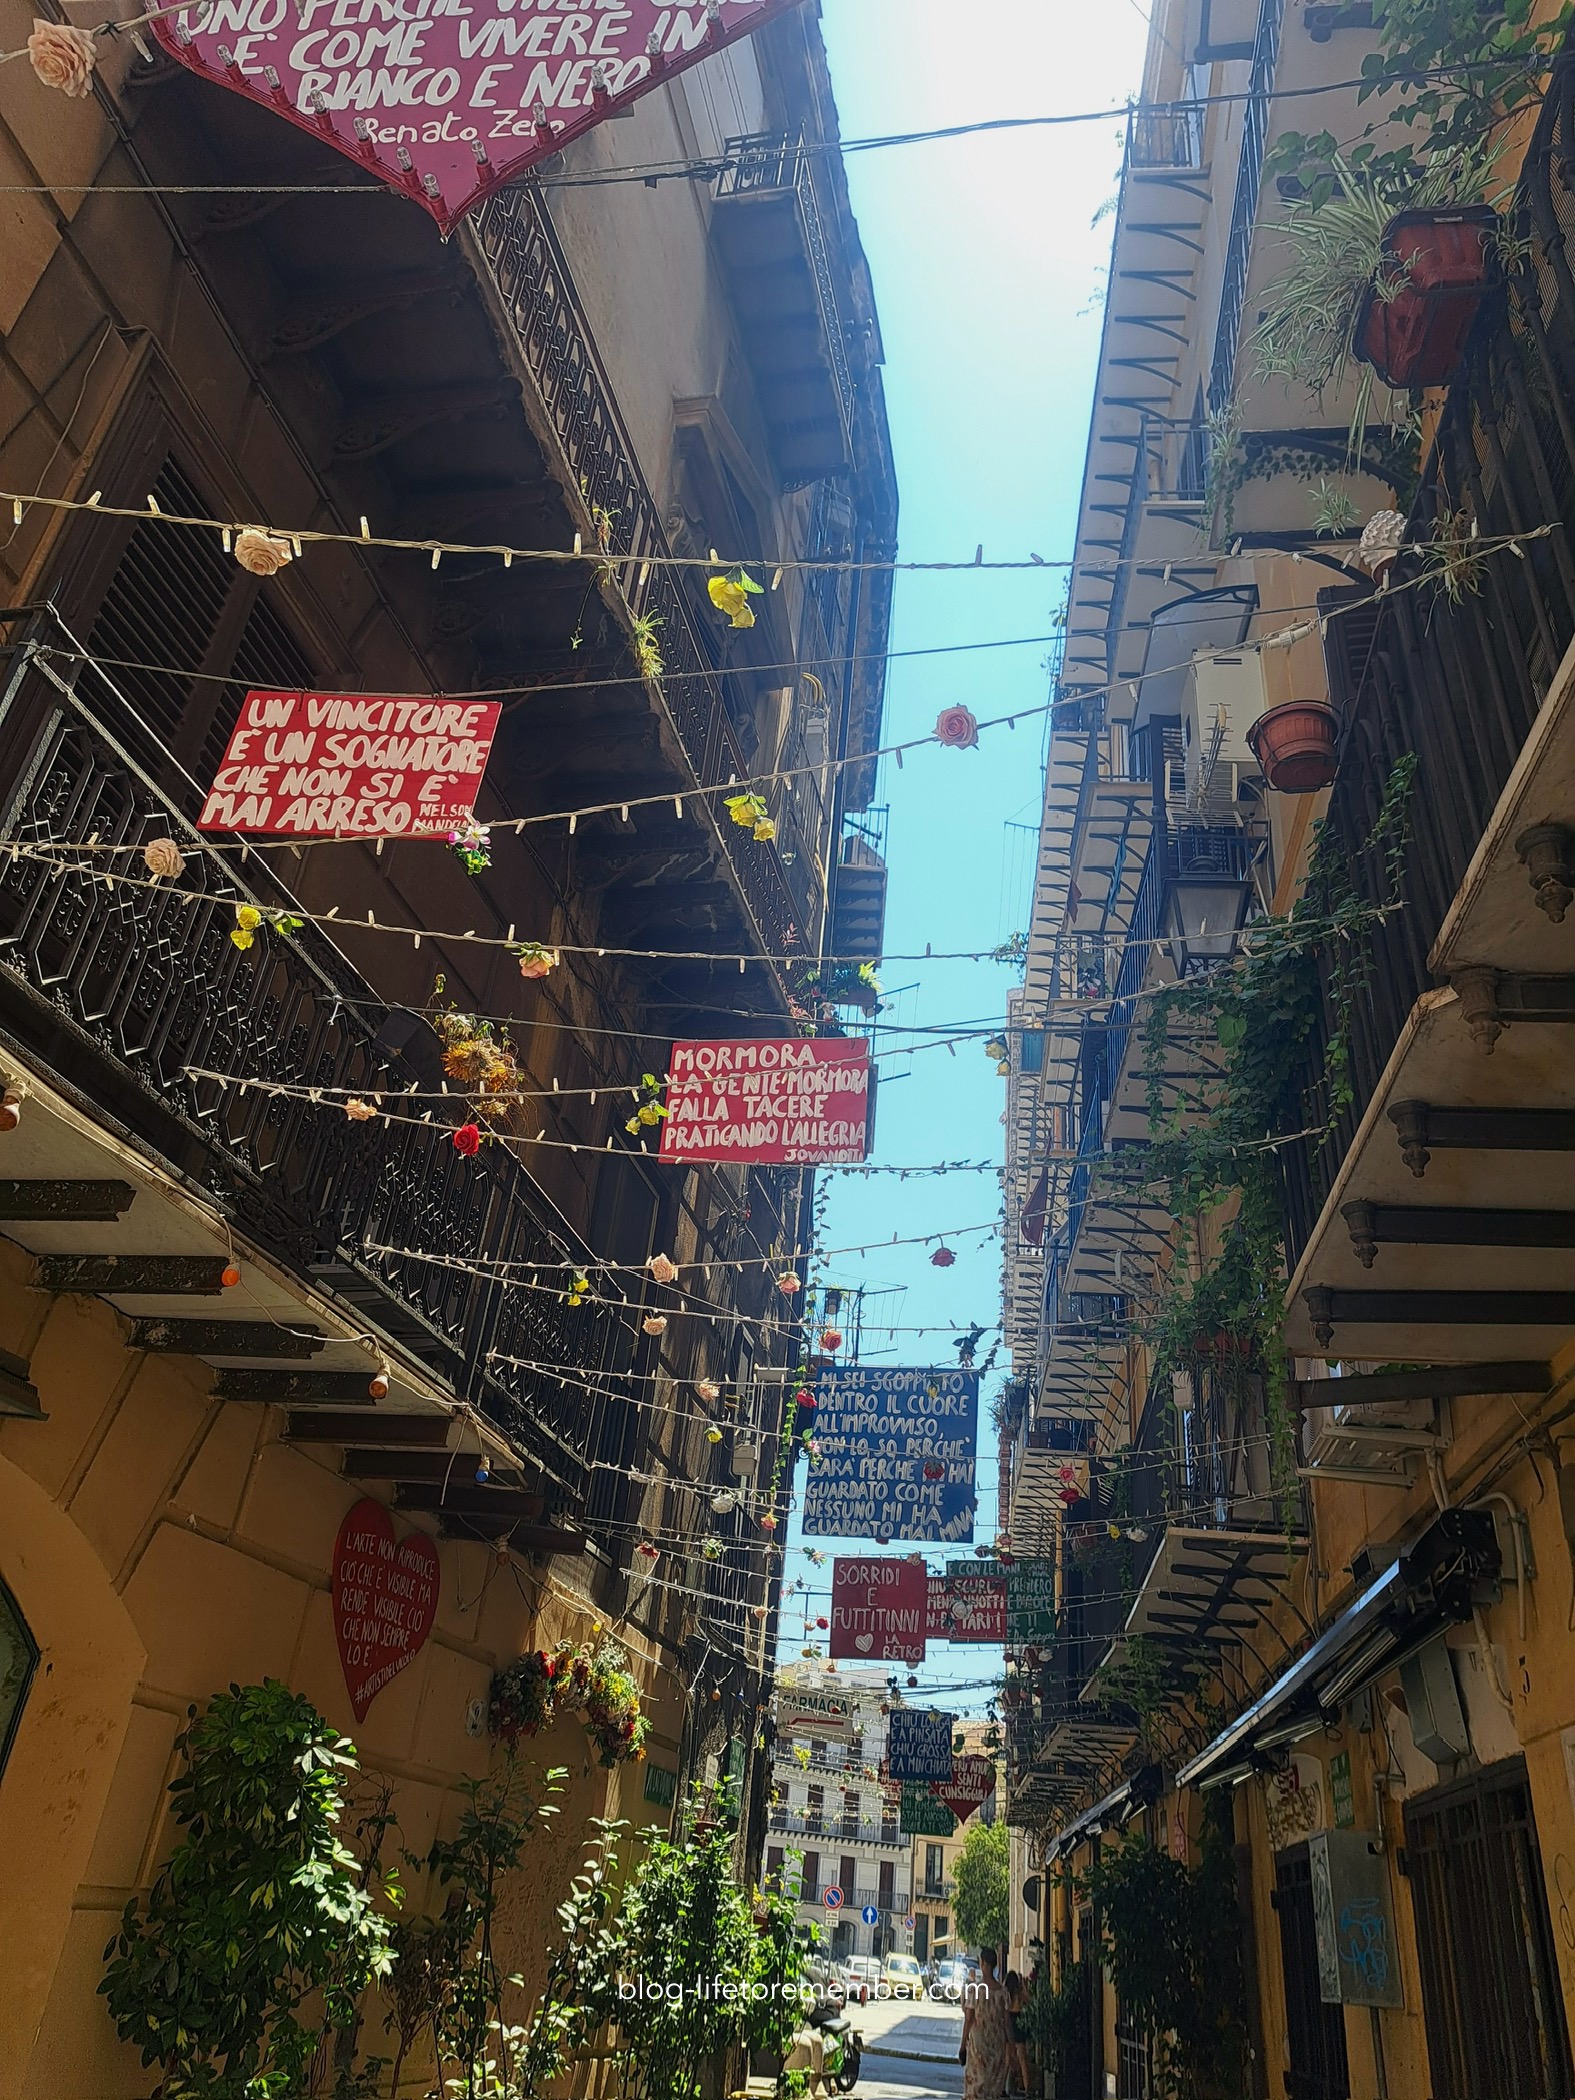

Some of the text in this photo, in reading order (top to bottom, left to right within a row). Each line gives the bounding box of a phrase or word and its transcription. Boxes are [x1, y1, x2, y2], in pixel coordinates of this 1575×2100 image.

[290, 20, 433, 70] COME
[459, 10, 632, 58] VIVERE
[645, 10, 709, 54] IN
[297, 55, 650, 115] BIANCO E NERO
[362, 111, 477, 143] Renato
[248, 699, 488, 737] UN VINCITORE
[264, 731, 317, 764] UN
[319, 734, 490, 774] SOGNATORE
[212, 765, 280, 794] CHE
[278, 767, 352, 797] NON
[359, 773, 404, 799] SI
[201, 792, 411, 833] MAI ARRESO
[670, 1067, 868, 1095] LA GENTE MORMORA
[668, 1094, 828, 1124] FALLA TACERE
[841, 1371, 865, 1390] SEI
[818, 1391, 970, 1416] DENTRO IL CUORE
[806, 1481, 945, 1506] GUARDATO COME
[804, 1499, 942, 1526] NESSUNO MI HA
[804, 1518, 894, 1537] GUARDATO
[939, 1505, 974, 1542] MINA
[346, 1532, 435, 1580] L'ARTE NON RIPRODUCE
[357, 1563, 375, 1586] CHE
[418, 1583, 431, 1605] MA
[836, 1563, 900, 1586] SORRIDI
[341, 1587, 369, 1615] RENDE
[374, 1594, 405, 1625] VISIBILE
[867, 1587, 878, 1606] E
[832, 1606, 920, 1633] FUTTITINNI
[342, 1617, 410, 1651] CHE NON SEMPRE
[885, 1633, 900, 1645] LA
[346, 1644, 361, 1665] LO
[783, 1695, 849, 1716] FARMACIA
[899, 1728, 906, 1740] A
[909, 1728, 949, 1745] PINSATA
[917, 1744, 951, 1760] GROSSA
[957, 1773, 981, 1787] SENTI
